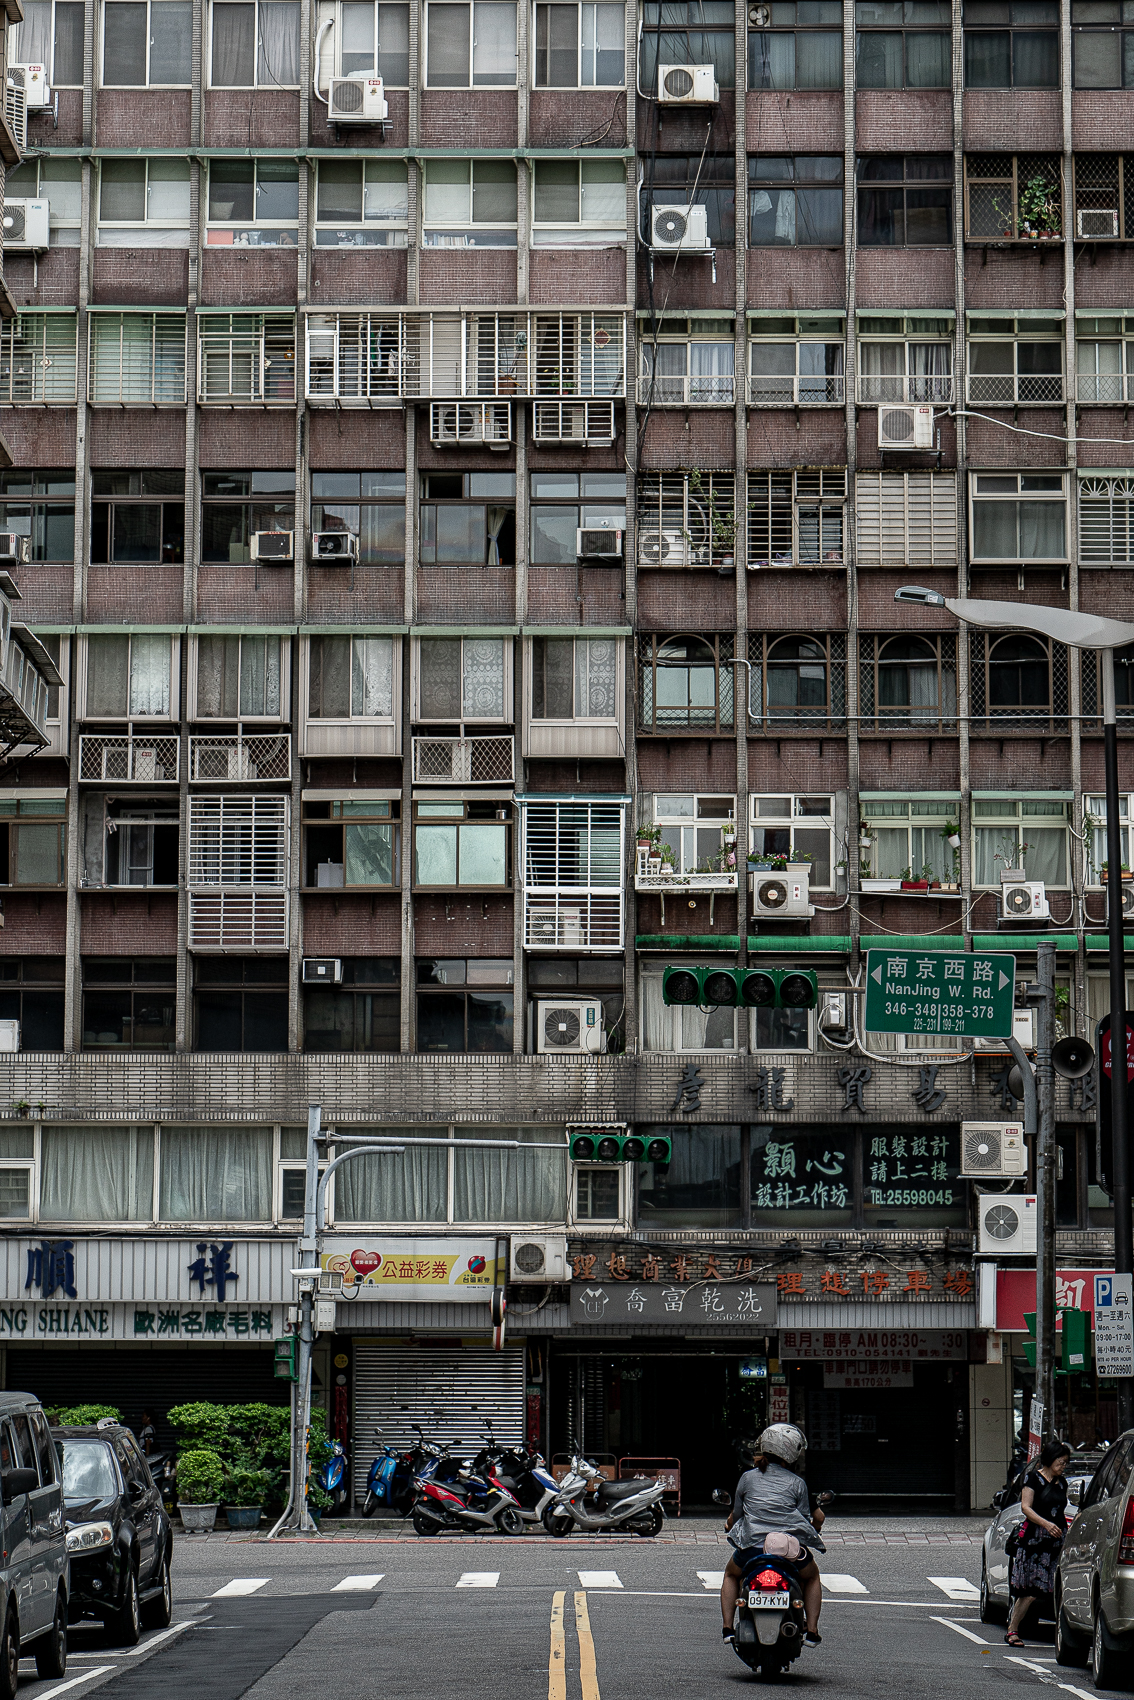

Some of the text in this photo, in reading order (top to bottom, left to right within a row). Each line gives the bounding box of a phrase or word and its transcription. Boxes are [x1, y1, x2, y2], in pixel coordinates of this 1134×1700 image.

[887, 956, 994, 981] 南京西路
[885, 983, 994, 999] NanJing W. Rd.
[885, 1002, 994, 1019] 346-348 358-378
[870, 1135, 950, 1157] 服裝設計
[869, 1161, 949, 1183] 請上二樓
[755, 1180, 849, 1209] 設計工作坊
[871, 1189, 953, 1205] TEL:25598045
[382, 1260, 448, 1279] 公益彩券
[777, 1270, 974, 1297] 理想停車場
[1098, 1280, 1110, 1304] P
[625, 1287, 762, 1313] 喬富乾洗
[0, 1309, 109, 1333] NG SHIANE
[134, 1310, 273, 1333] 歐洲名廠毛料
[706, 1313, 760, 1321] 25562022
[772, 1386, 788, 1422] 車位出
